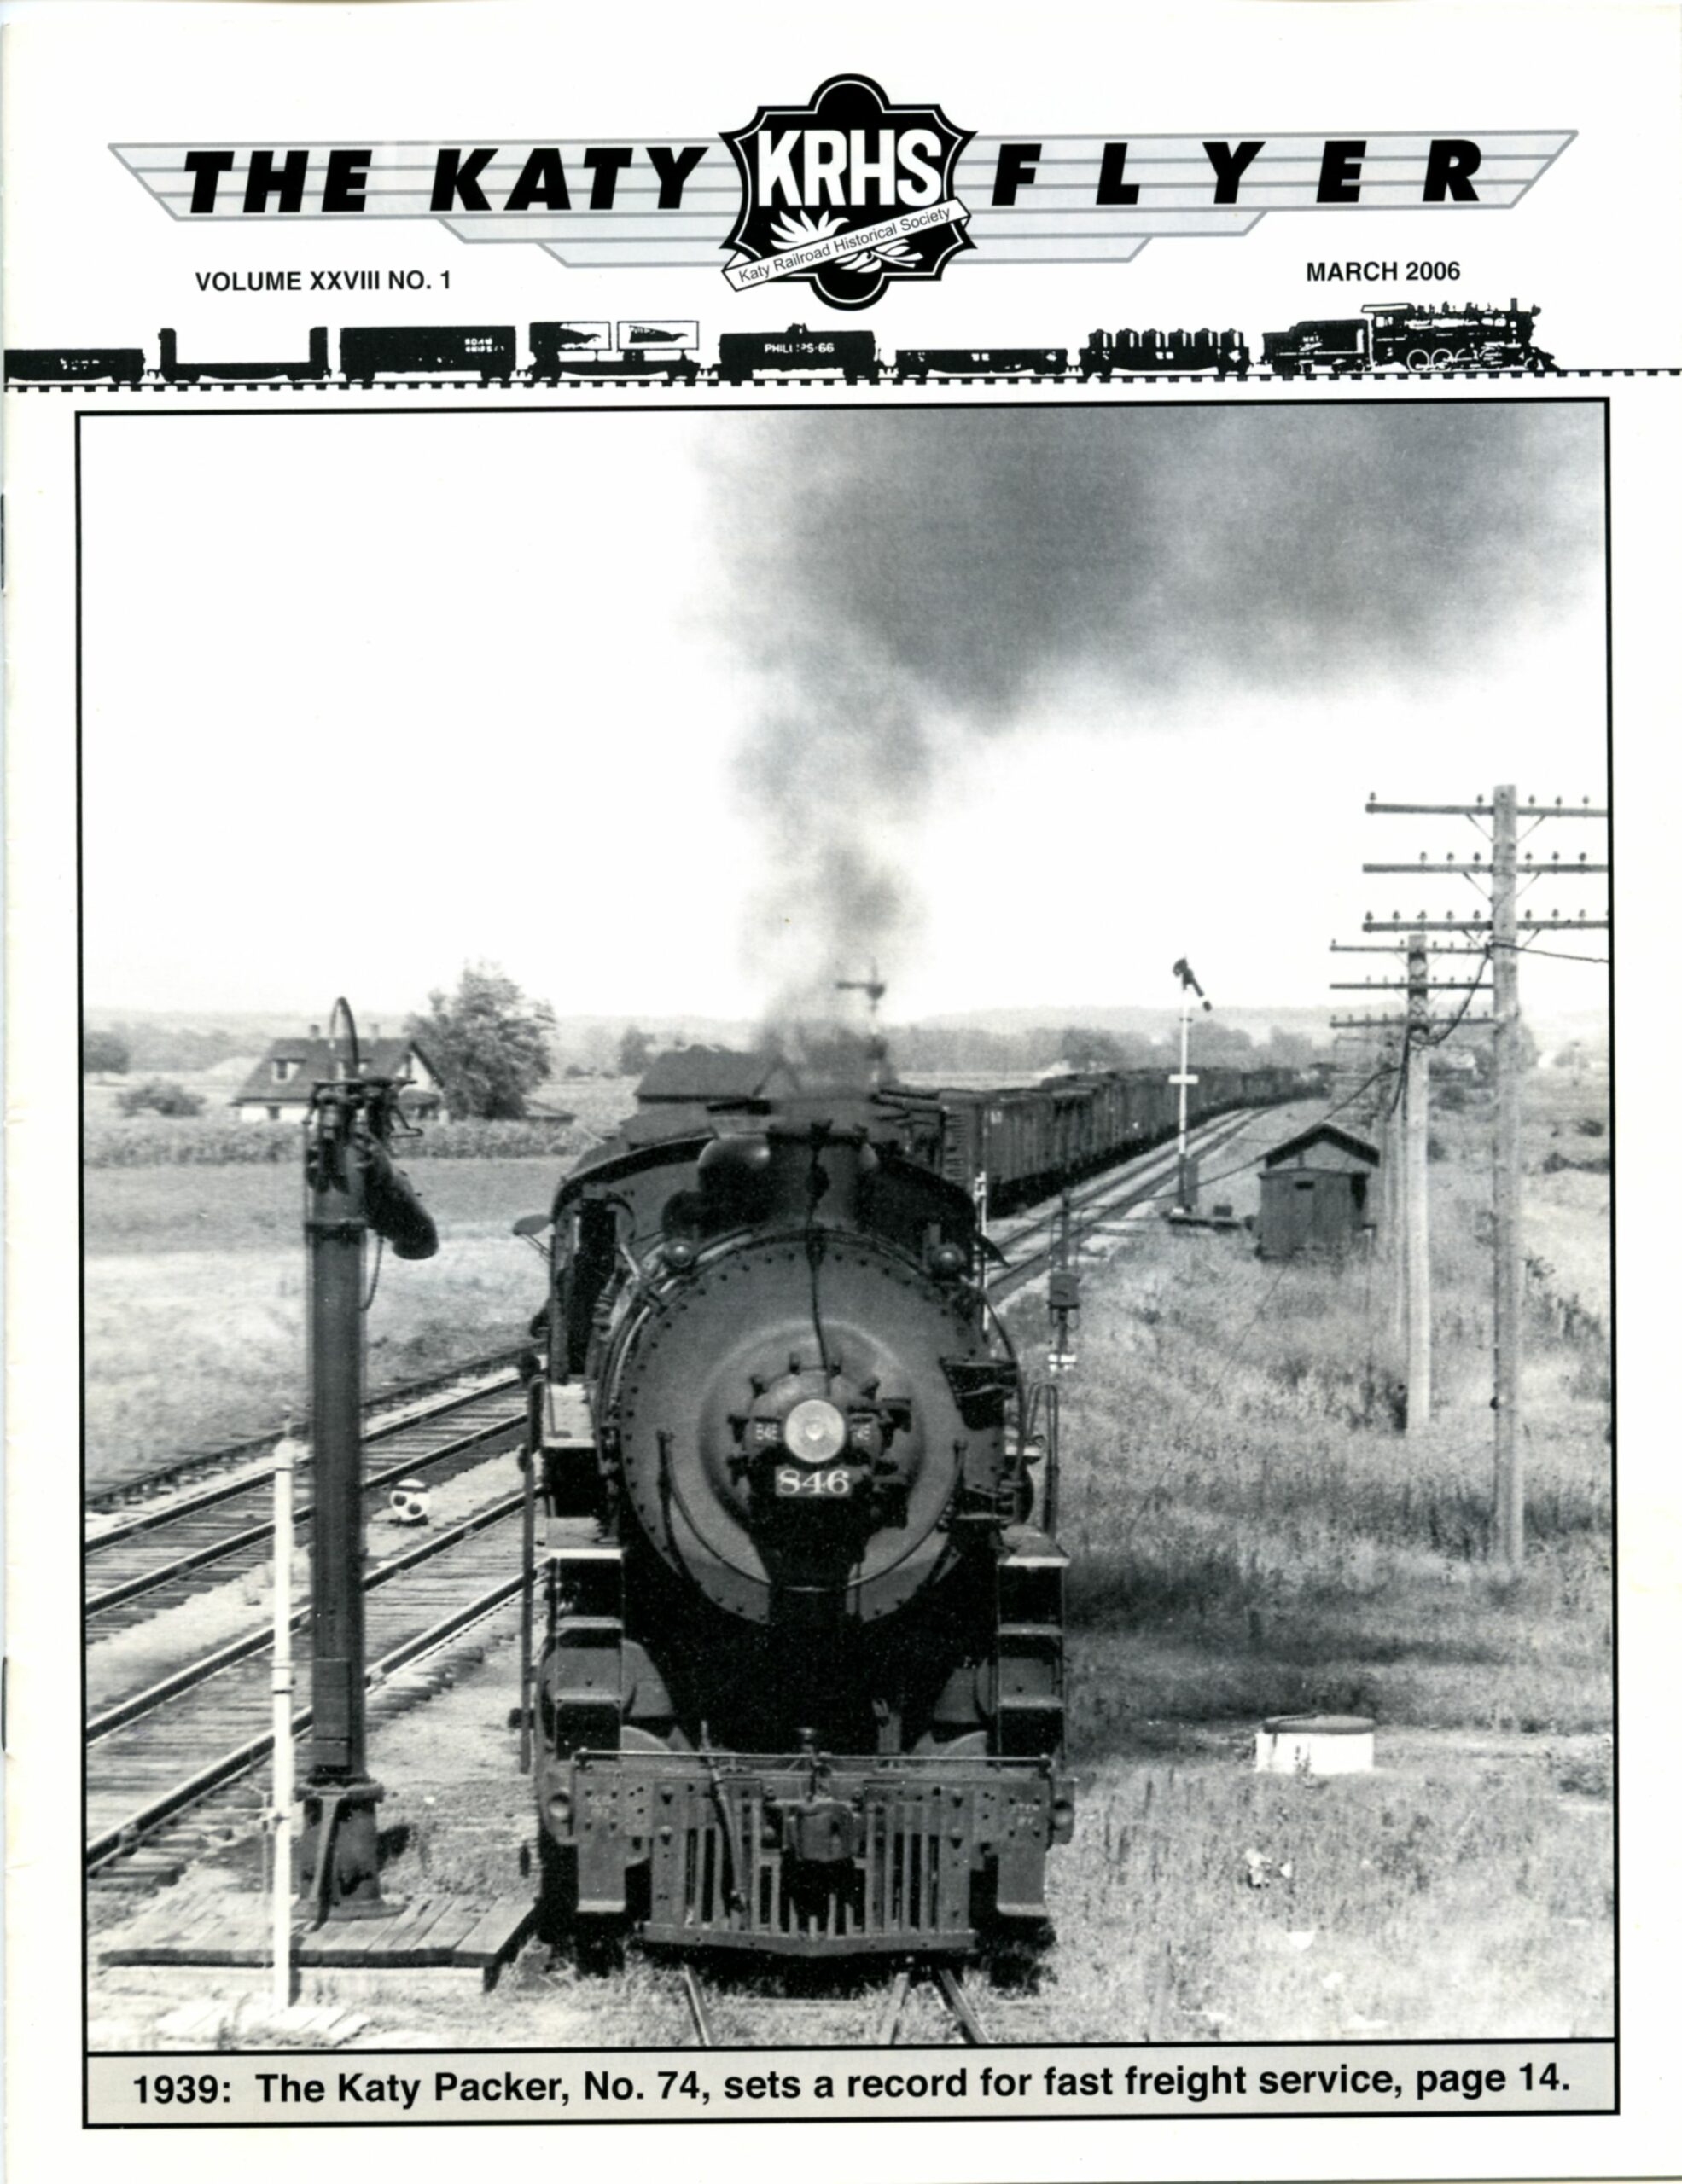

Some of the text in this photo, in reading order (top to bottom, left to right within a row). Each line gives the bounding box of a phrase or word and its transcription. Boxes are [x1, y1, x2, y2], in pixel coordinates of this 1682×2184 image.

[183, 147, 709, 213] THE KATY
[758, 129, 942, 207] KRHS
[992, 139, 1481, 206] FLYER
[739, 207, 950, 282] Katy Railroad Historical Society
[1307, 261, 1461, 282] MARCH 2006
[195, 270, 450, 292] VOLUME XXVIII NO. 1
[778, 1469, 850, 1494] 846
[133, 2062, 1570, 2110] 1939: The Katy Packer, No. 74, sets a record for fast freight service, page 14.
